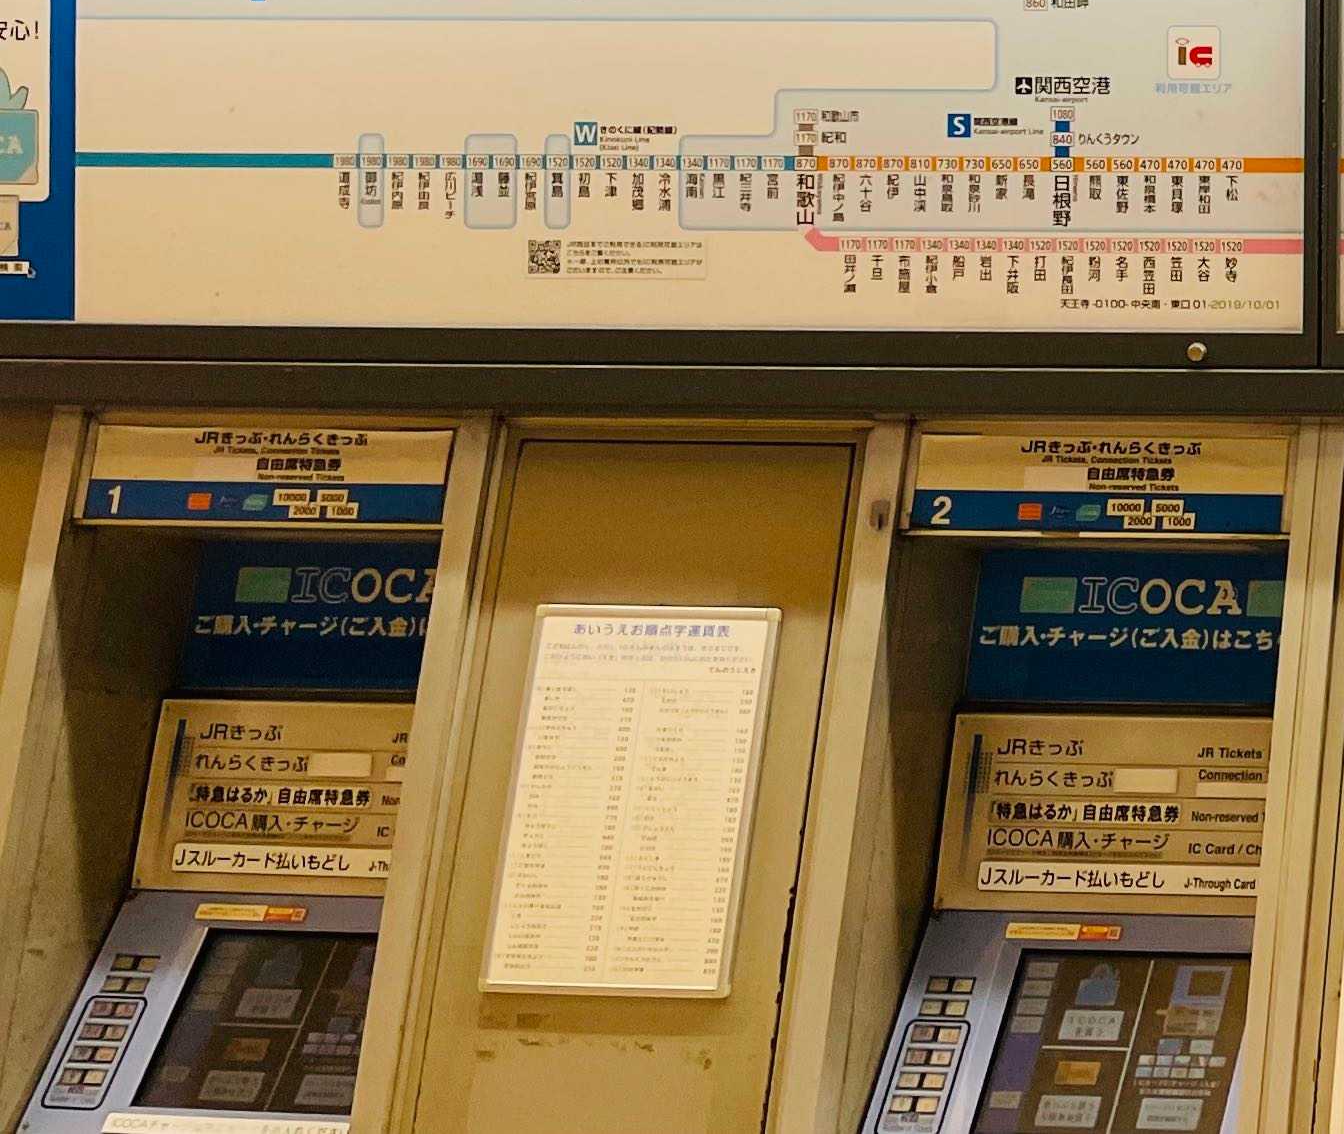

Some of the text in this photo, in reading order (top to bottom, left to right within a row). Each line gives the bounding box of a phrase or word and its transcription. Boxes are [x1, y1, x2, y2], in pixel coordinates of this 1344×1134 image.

[1034, 76, 1111, 96] 関西空港
[797, 174, 815, 227] 和歌山
[1053, 174, 1071, 228] 日根野
[1087, 467, 1176, 481] 自由席特急券
[107, 485, 122, 515] 1
[931, 496, 952, 525] 2
[1078, 577, 1243, 616] ICOCA
[200, 723, 283, 742] JRきっぷ
[997, 738, 1084, 757] JRきっぷ
[1197, 746, 1263, 760] JR Tickets
[195, 754, 309, 773] れんらくきっぷ
[994, 769, 1113, 789] れんらくきっぷ
[1198, 769, 1263, 782] Connection
[1191, 810, 1261, 824] Non-reserved
[1188, 842, 1234, 855] IC Card
[980, 868, 1165, 889] Jスルーカード払いもどし
[1184, 878, 1256, 892] J-Through Card
